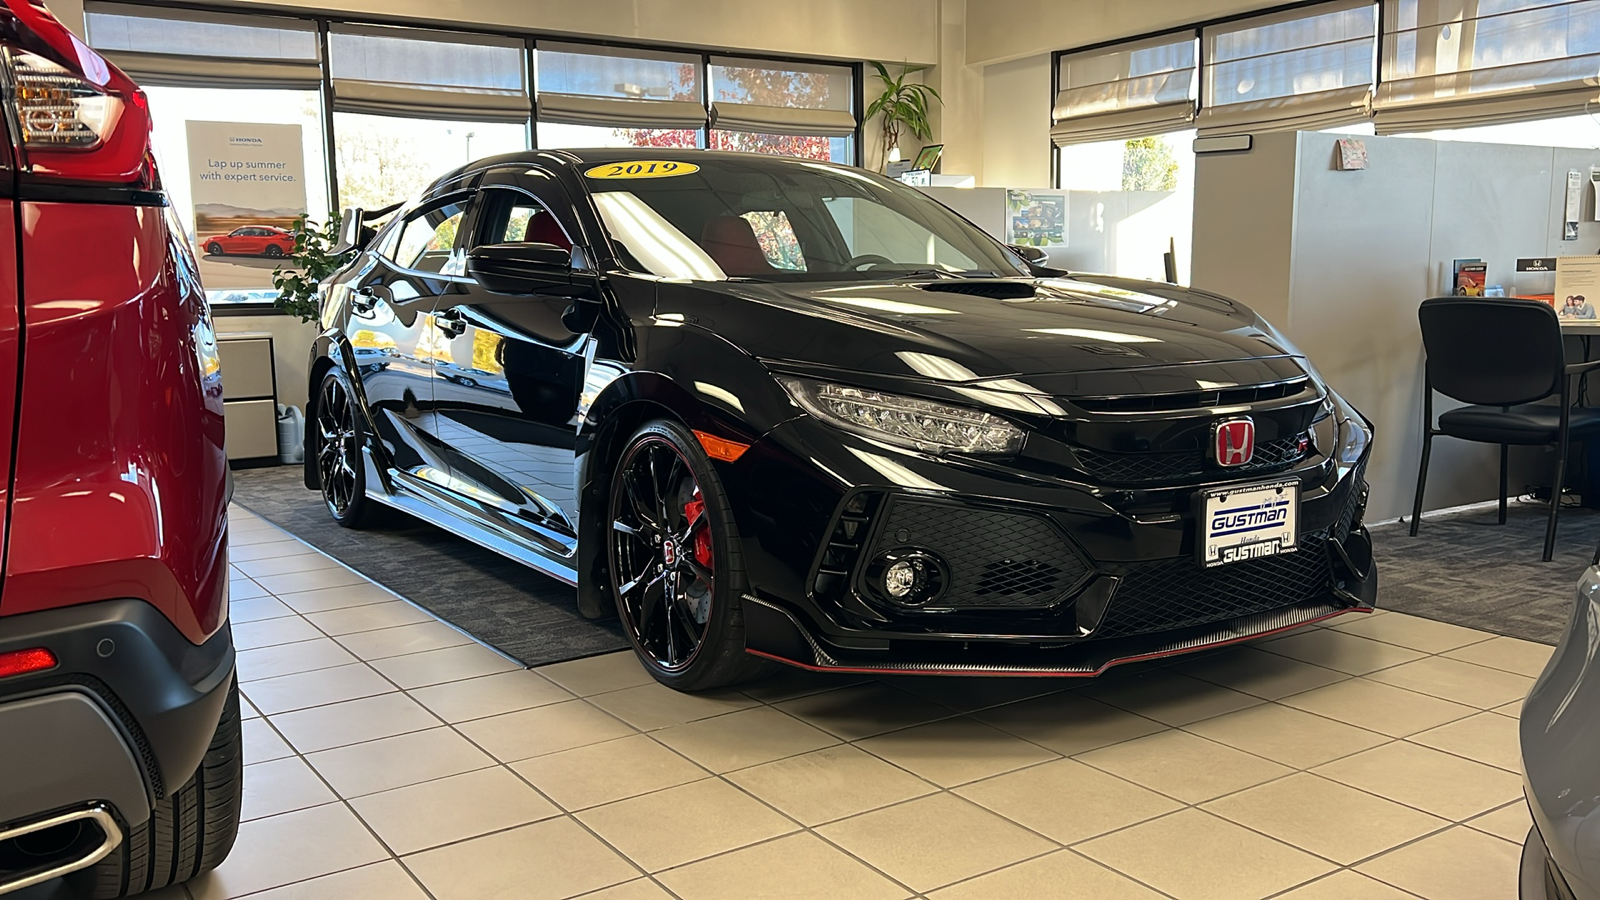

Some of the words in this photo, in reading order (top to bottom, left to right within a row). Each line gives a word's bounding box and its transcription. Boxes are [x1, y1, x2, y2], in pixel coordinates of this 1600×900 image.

[208, 159, 227, 170] Lap
[230, 161, 243, 170] up
[245, 161, 286, 169] summer
[607, 163, 678, 177] 2019
[199, 171, 221, 180] with
[224, 173, 257, 183] expert
[258, 173, 296, 182] service.
[1210, 481, 1299, 498] www.gustmanhonda.com
